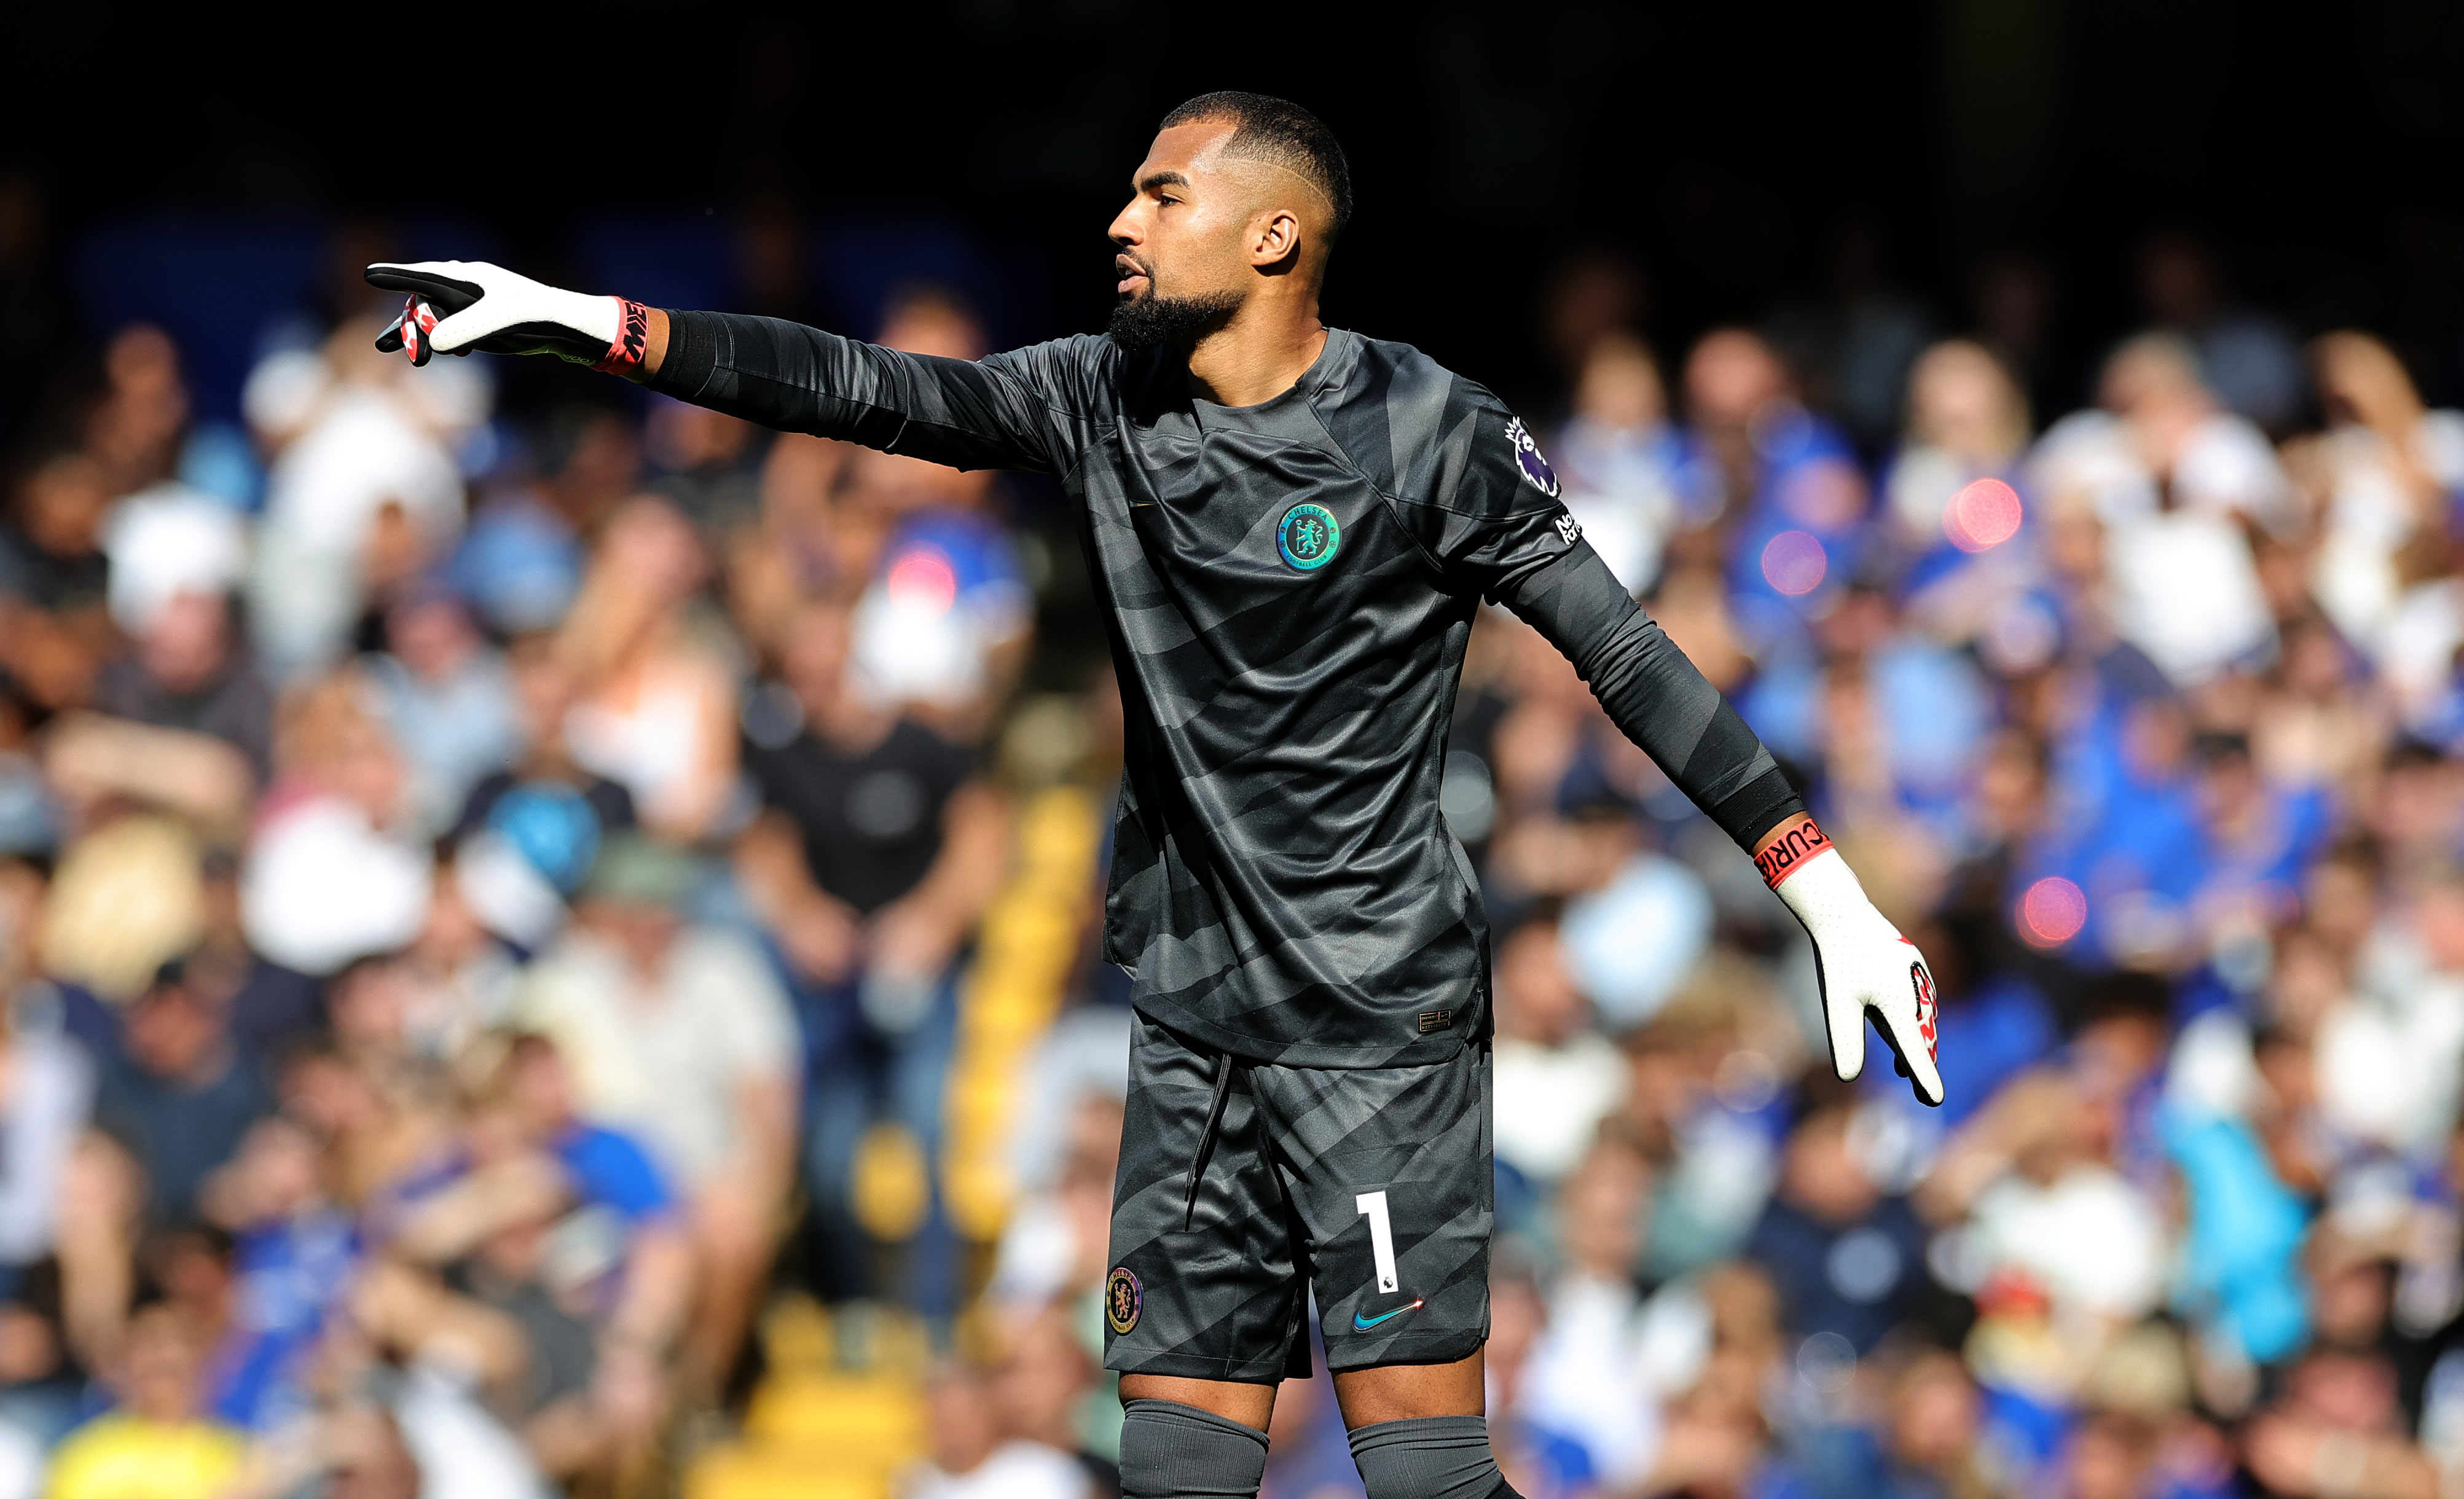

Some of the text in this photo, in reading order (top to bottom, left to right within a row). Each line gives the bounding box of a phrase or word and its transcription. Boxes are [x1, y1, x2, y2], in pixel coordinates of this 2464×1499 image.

[1288, 506, 1328, 522] CHELSEA
[1286, 555, 1327, 566] FOOTBALL CLUB
[1356, 1191, 1399, 1294] 1
[1110, 1270, 1133, 1283] CHELSEA
